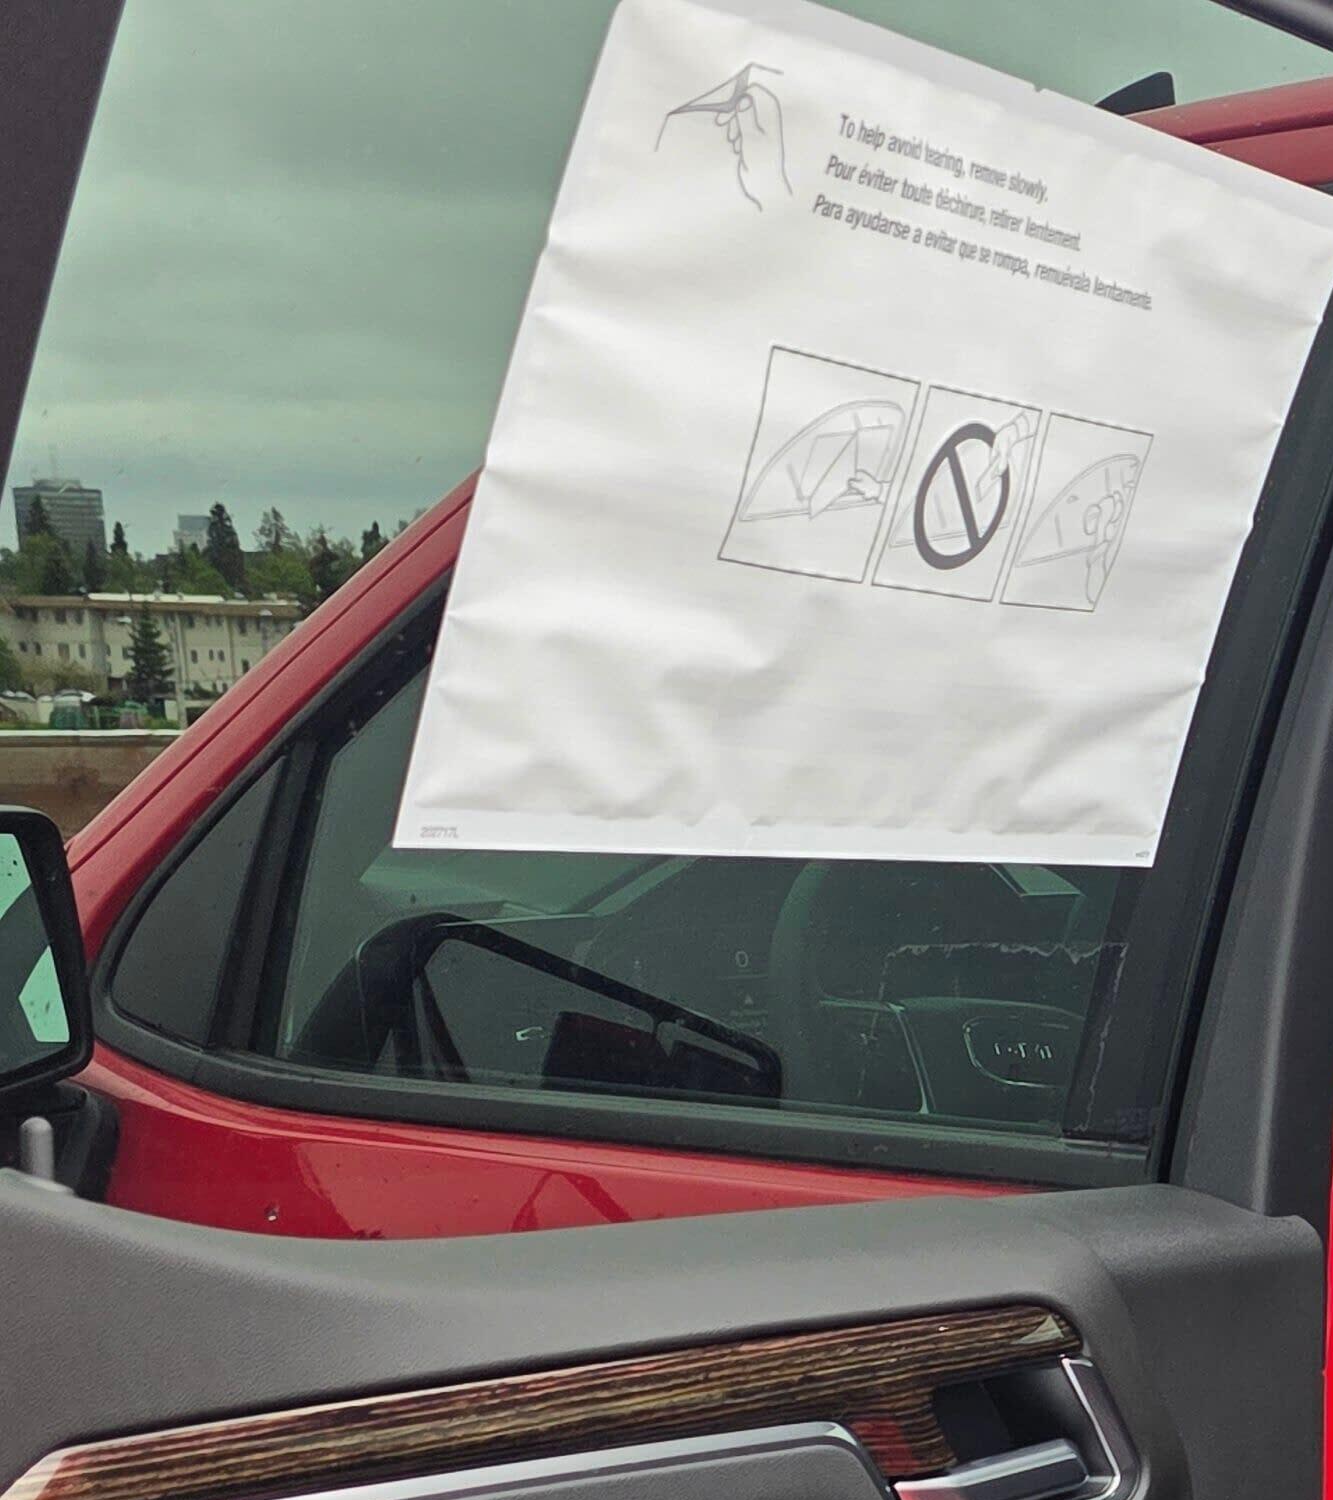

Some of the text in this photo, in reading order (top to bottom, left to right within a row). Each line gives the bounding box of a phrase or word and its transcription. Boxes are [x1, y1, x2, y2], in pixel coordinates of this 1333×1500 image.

[825, 154, 858, 182] Pour
[857, 161, 898, 194] éviter
[900, 177, 933, 206] toute
[840, 114, 1048, 204] To help avoid tearing, remove slowly.
[812, 193, 844, 221] Para
[845, 207, 911, 240] ayudarse
[912, 227, 923, 244] a
[924, 230, 958, 255] evitar
[958, 240, 978, 262] que
[979, 247, 991, 263] se
